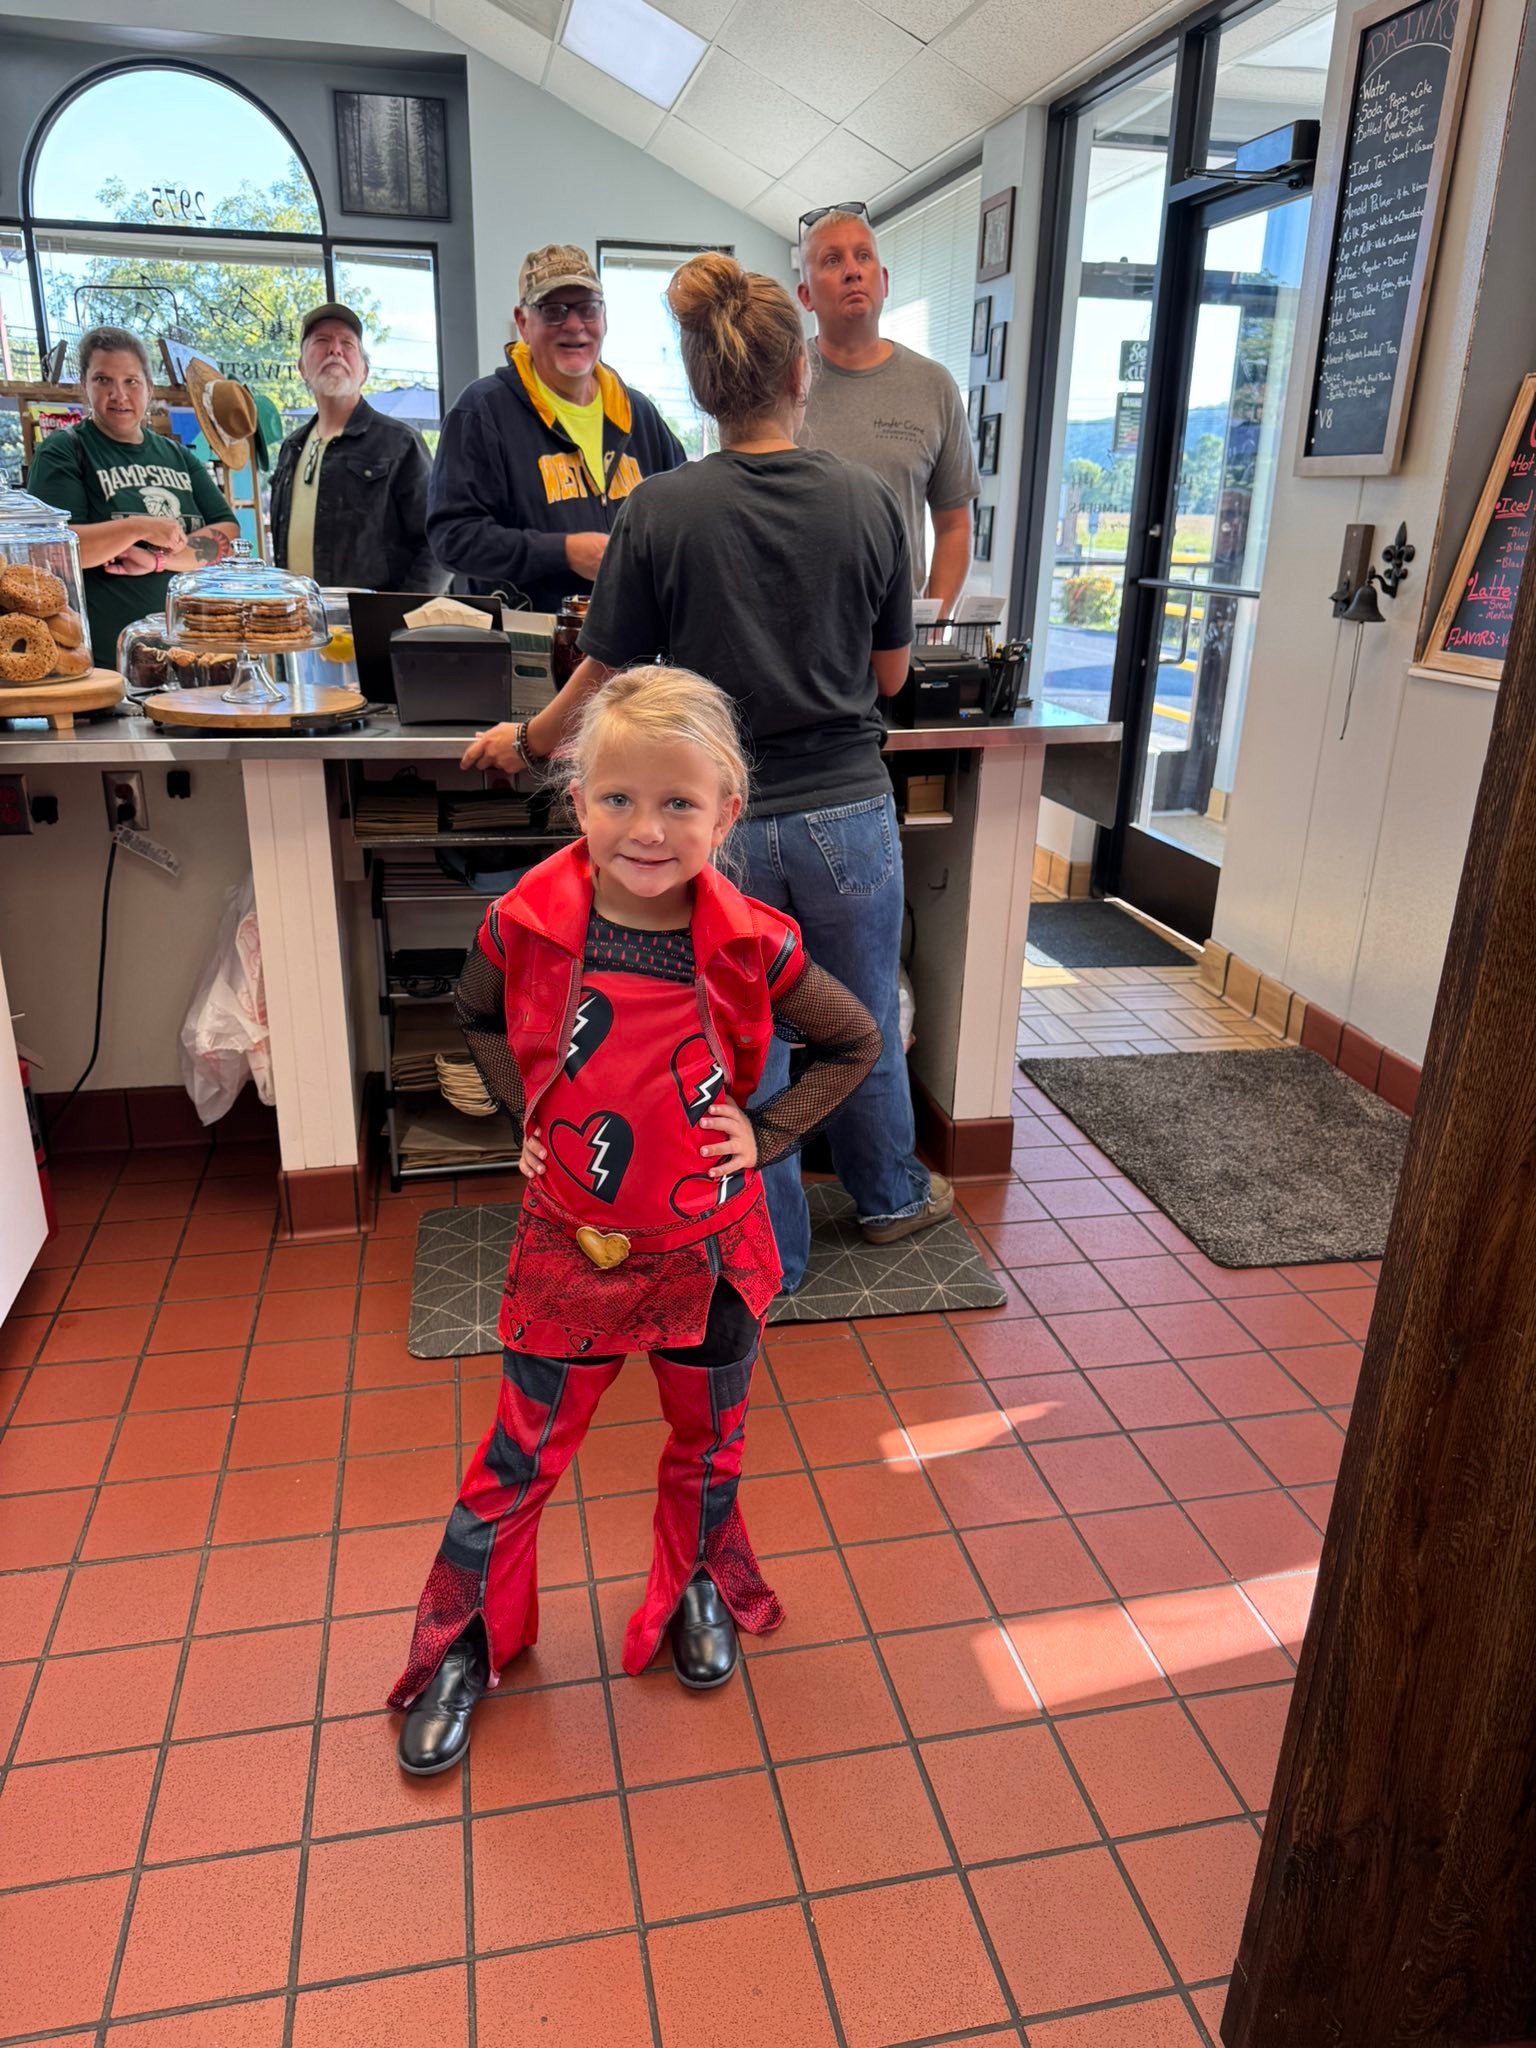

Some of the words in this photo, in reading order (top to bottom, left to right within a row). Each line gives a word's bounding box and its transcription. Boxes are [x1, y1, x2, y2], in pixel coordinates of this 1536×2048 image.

[1364, 0, 1459, 72] DRINKS
[1361, 74, 1390, 100] Water
[1389, 92, 1407, 110] Pepsi
[1415, 80, 1432, 98] Coke
[1356, 119, 1382, 144] Bottled
[1384, 112, 1400, 130] Root
[1401, 104, 1424, 124] Beer
[1406, 117, 1424, 137] Soda
[1350, 159, 1371, 178] Iced
[1348, 174, 1383, 197] Lemonade
[1343, 198, 1367, 222] Arnold
[1343, 226, 1359, 243] Milk
[1387, 251, 1408, 267] Decaf
[1334, 288, 1346, 307] Hot
[1331, 311, 1343, 328] Hot
[1346, 304, 1376, 322] Chocolate
[1329, 331, 1347, 346] Pickle
[1349, 328, 1368, 341] Juice
[1319, 408, 1333, 429] V8
[1513, 453, 1535, 472] Hot
[1497, 489, 1534, 513] Iced
